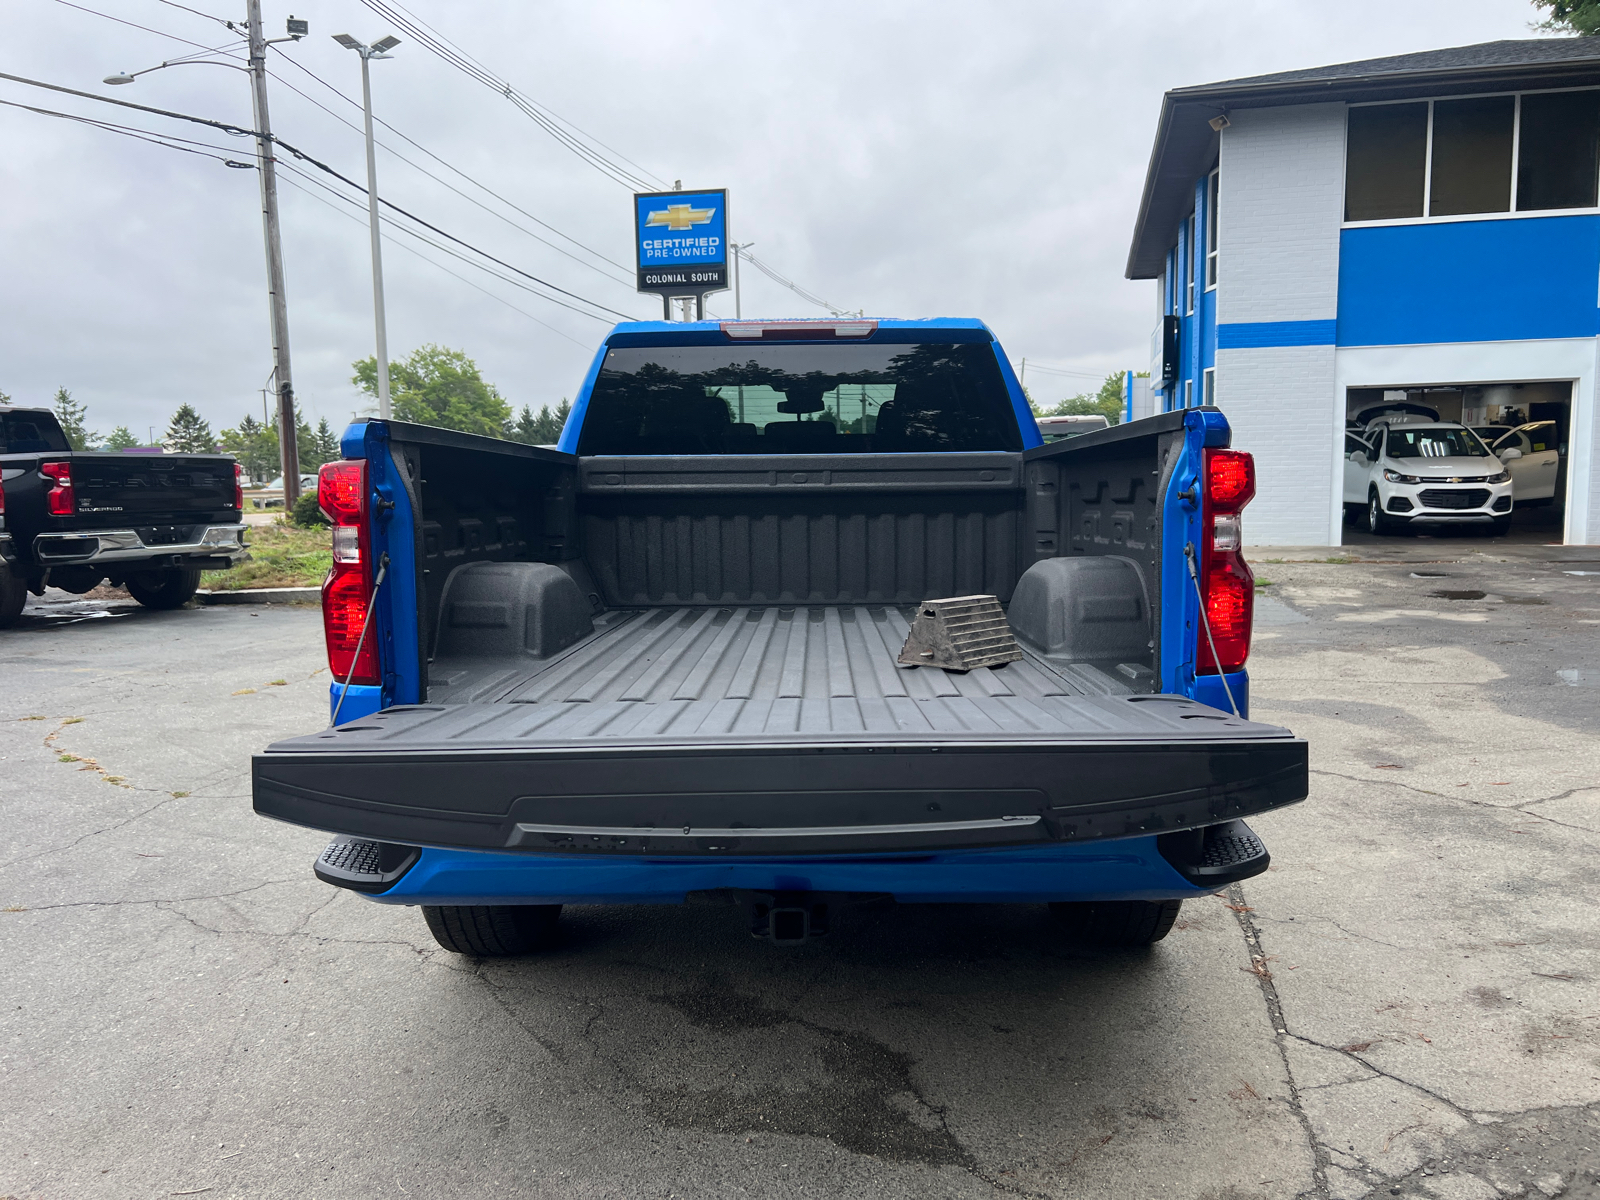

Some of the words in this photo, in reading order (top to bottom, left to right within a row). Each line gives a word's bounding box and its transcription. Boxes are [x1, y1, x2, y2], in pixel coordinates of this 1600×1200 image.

[642, 237, 720, 249] CERTIFIED
[646, 246, 716, 258] PRE-OWNED
[645, 274, 687, 284] COLONIAL
[691, 272, 719, 282] SOUTH
